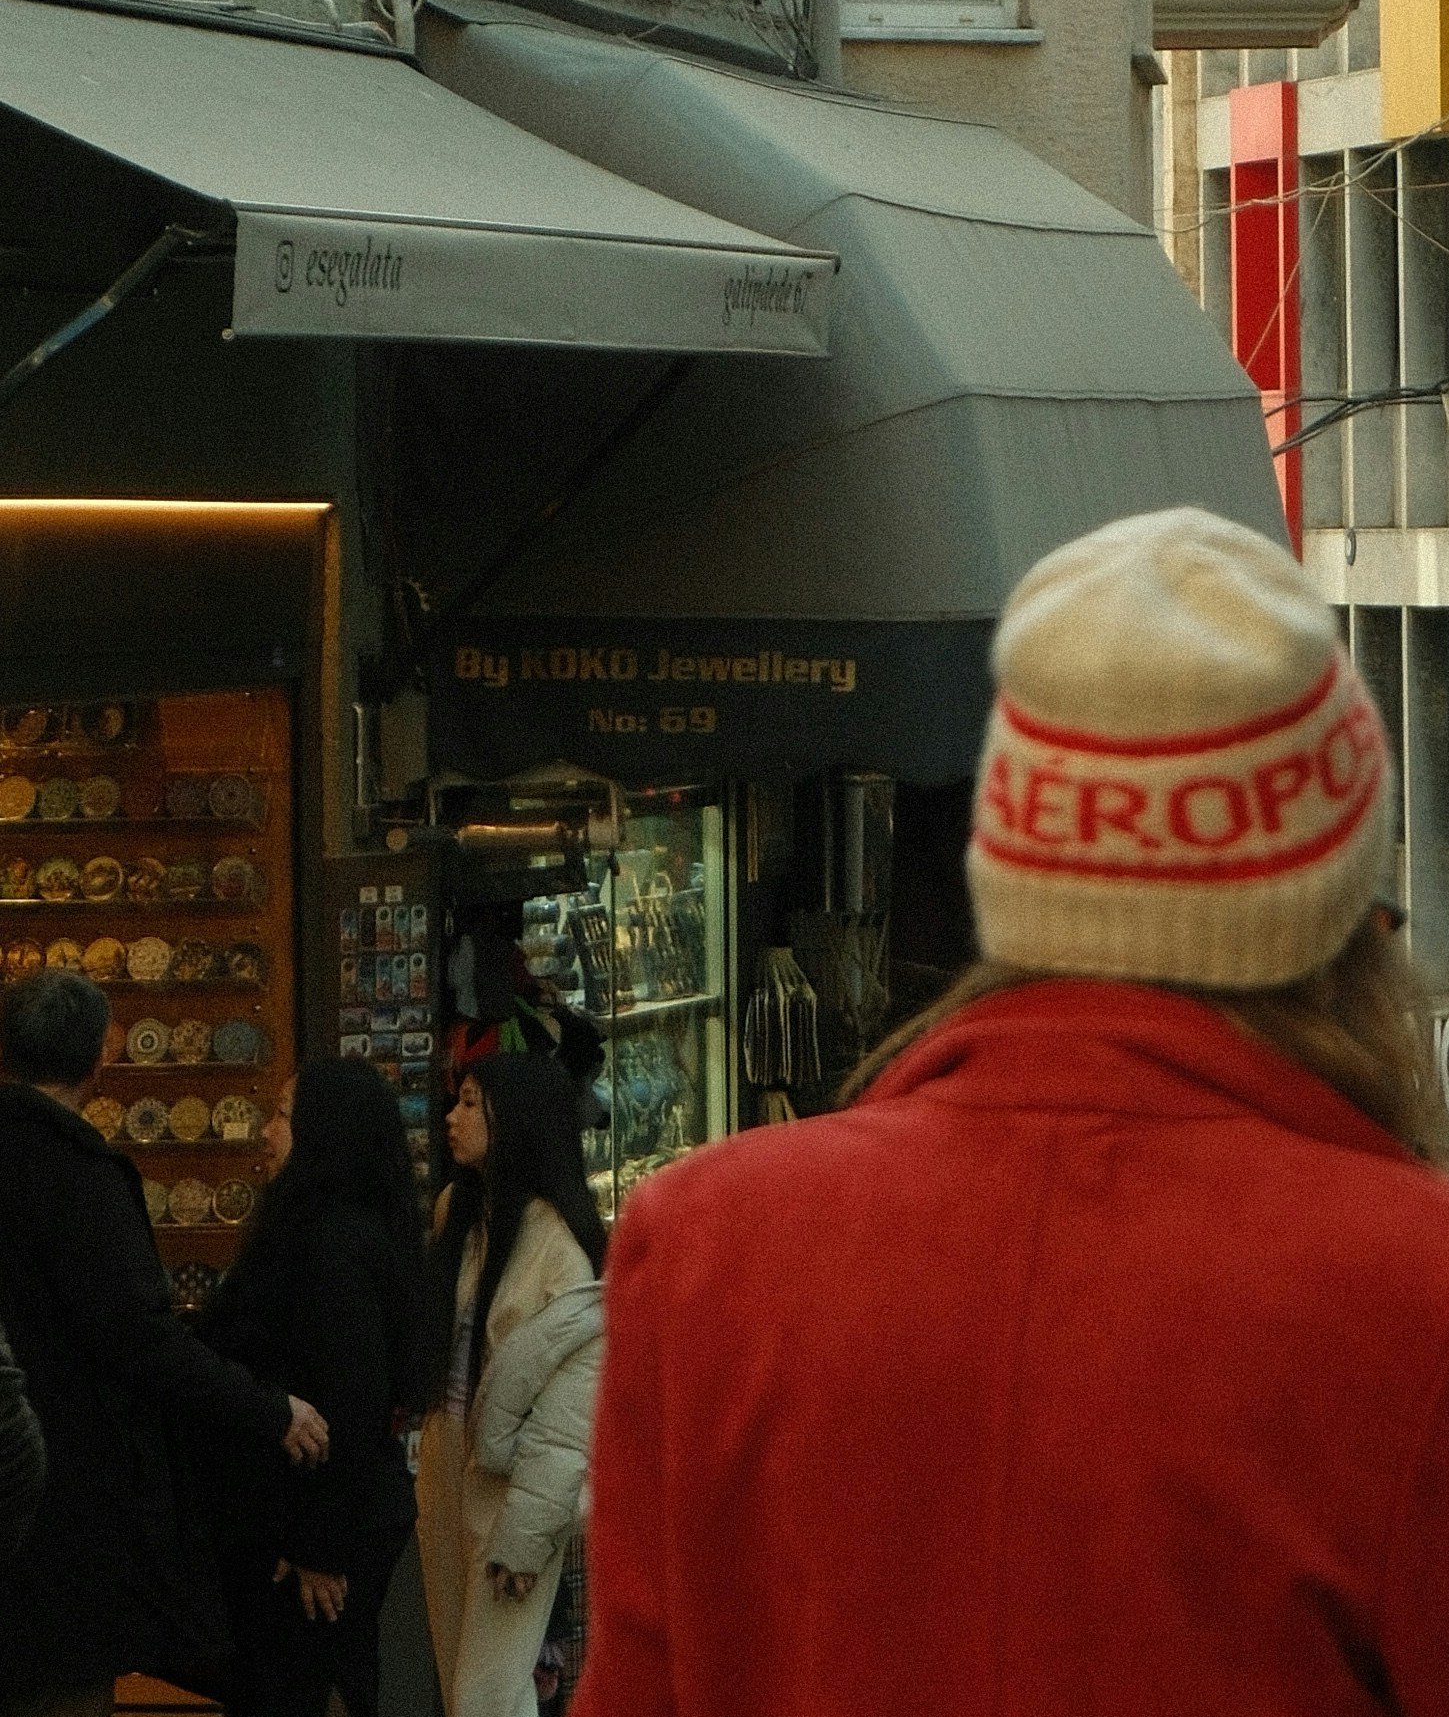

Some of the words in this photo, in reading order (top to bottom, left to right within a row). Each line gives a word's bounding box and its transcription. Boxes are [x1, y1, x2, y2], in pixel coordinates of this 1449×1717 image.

[307, 234, 402, 307] esegalata
[454, 646, 509, 687] By
[520, 648, 638, 681] KOKO
[647, 649, 857, 693] Jewellery
[588, 707, 647, 733] No:
